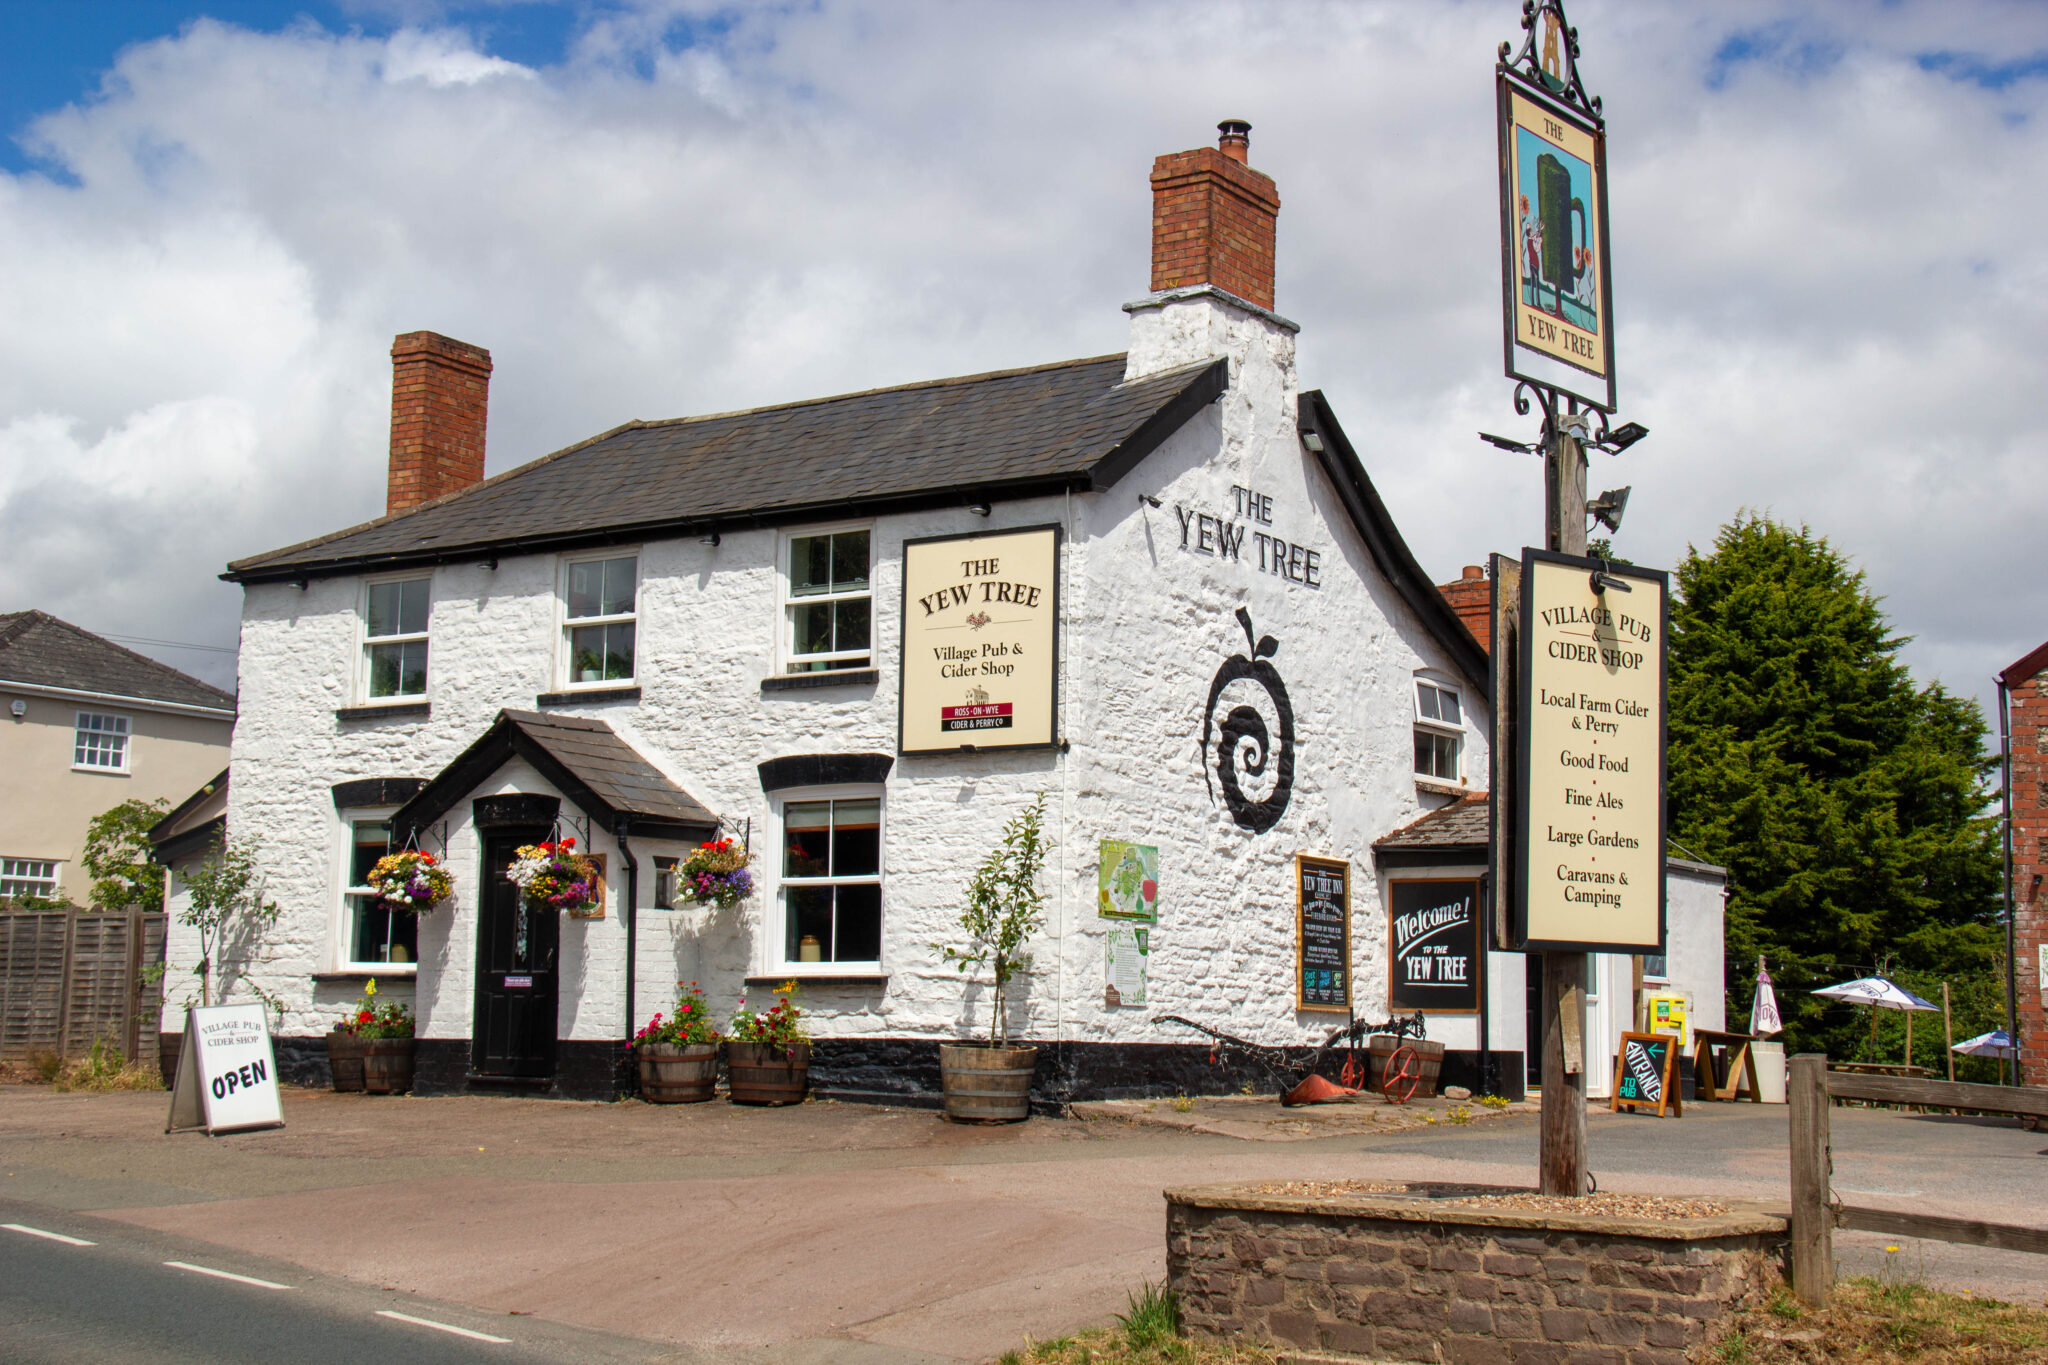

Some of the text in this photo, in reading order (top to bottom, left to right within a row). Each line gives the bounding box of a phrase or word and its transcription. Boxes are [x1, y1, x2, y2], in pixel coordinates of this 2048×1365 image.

[1544, 118, 1564, 142] THE
[1528, 314, 1594, 360] YEW TREE
[1230, 484, 1273, 526] THE
[1174, 504, 1320, 590] YEW TREE
[961, 558, 1000, 577] THE
[918, 581, 1042, 618] YEW TREE
[1541, 606, 1650, 642] VILLAGE PUB
[1592, 629, 1601, 642] &
[933, 642, 1023, 663] Village Pub &
[1548, 640, 1643, 670] CIDER SHOP
[941, 662, 1014, 678] Cider Shop
[1541, 688, 1649, 718] Local Farm Cider
[950, 720, 968, 730] CIDER
[969, 720, 975, 728] &
[976, 719, 995, 728] PERRY
[1572, 714, 1618, 737] & Perry
[1560, 750, 1628, 772] Good Food
[1565, 788, 1624, 810] Fine Ales
[1548, 826, 1639, 849] Large Gardens
[1557, 864, 1628, 885] Caravans &
[1564, 885, 1621, 908] Camping
[1394, 896, 1470, 948] Welcome!
[1422, 945, 1448, 954] TO THE
[1406, 956, 1467, 980] YEW TREE
[202, 1021, 261, 1034] VILLAGE PUB
[208, 1036, 259, 1047] CIDER SHOP
[212, 1059, 267, 1100] OPEN
[1624, 1077, 1635, 1088] TO
[1626, 1040, 1661, 1102] ENTRANCE
[1619, 1086, 1636, 1098] PUB
